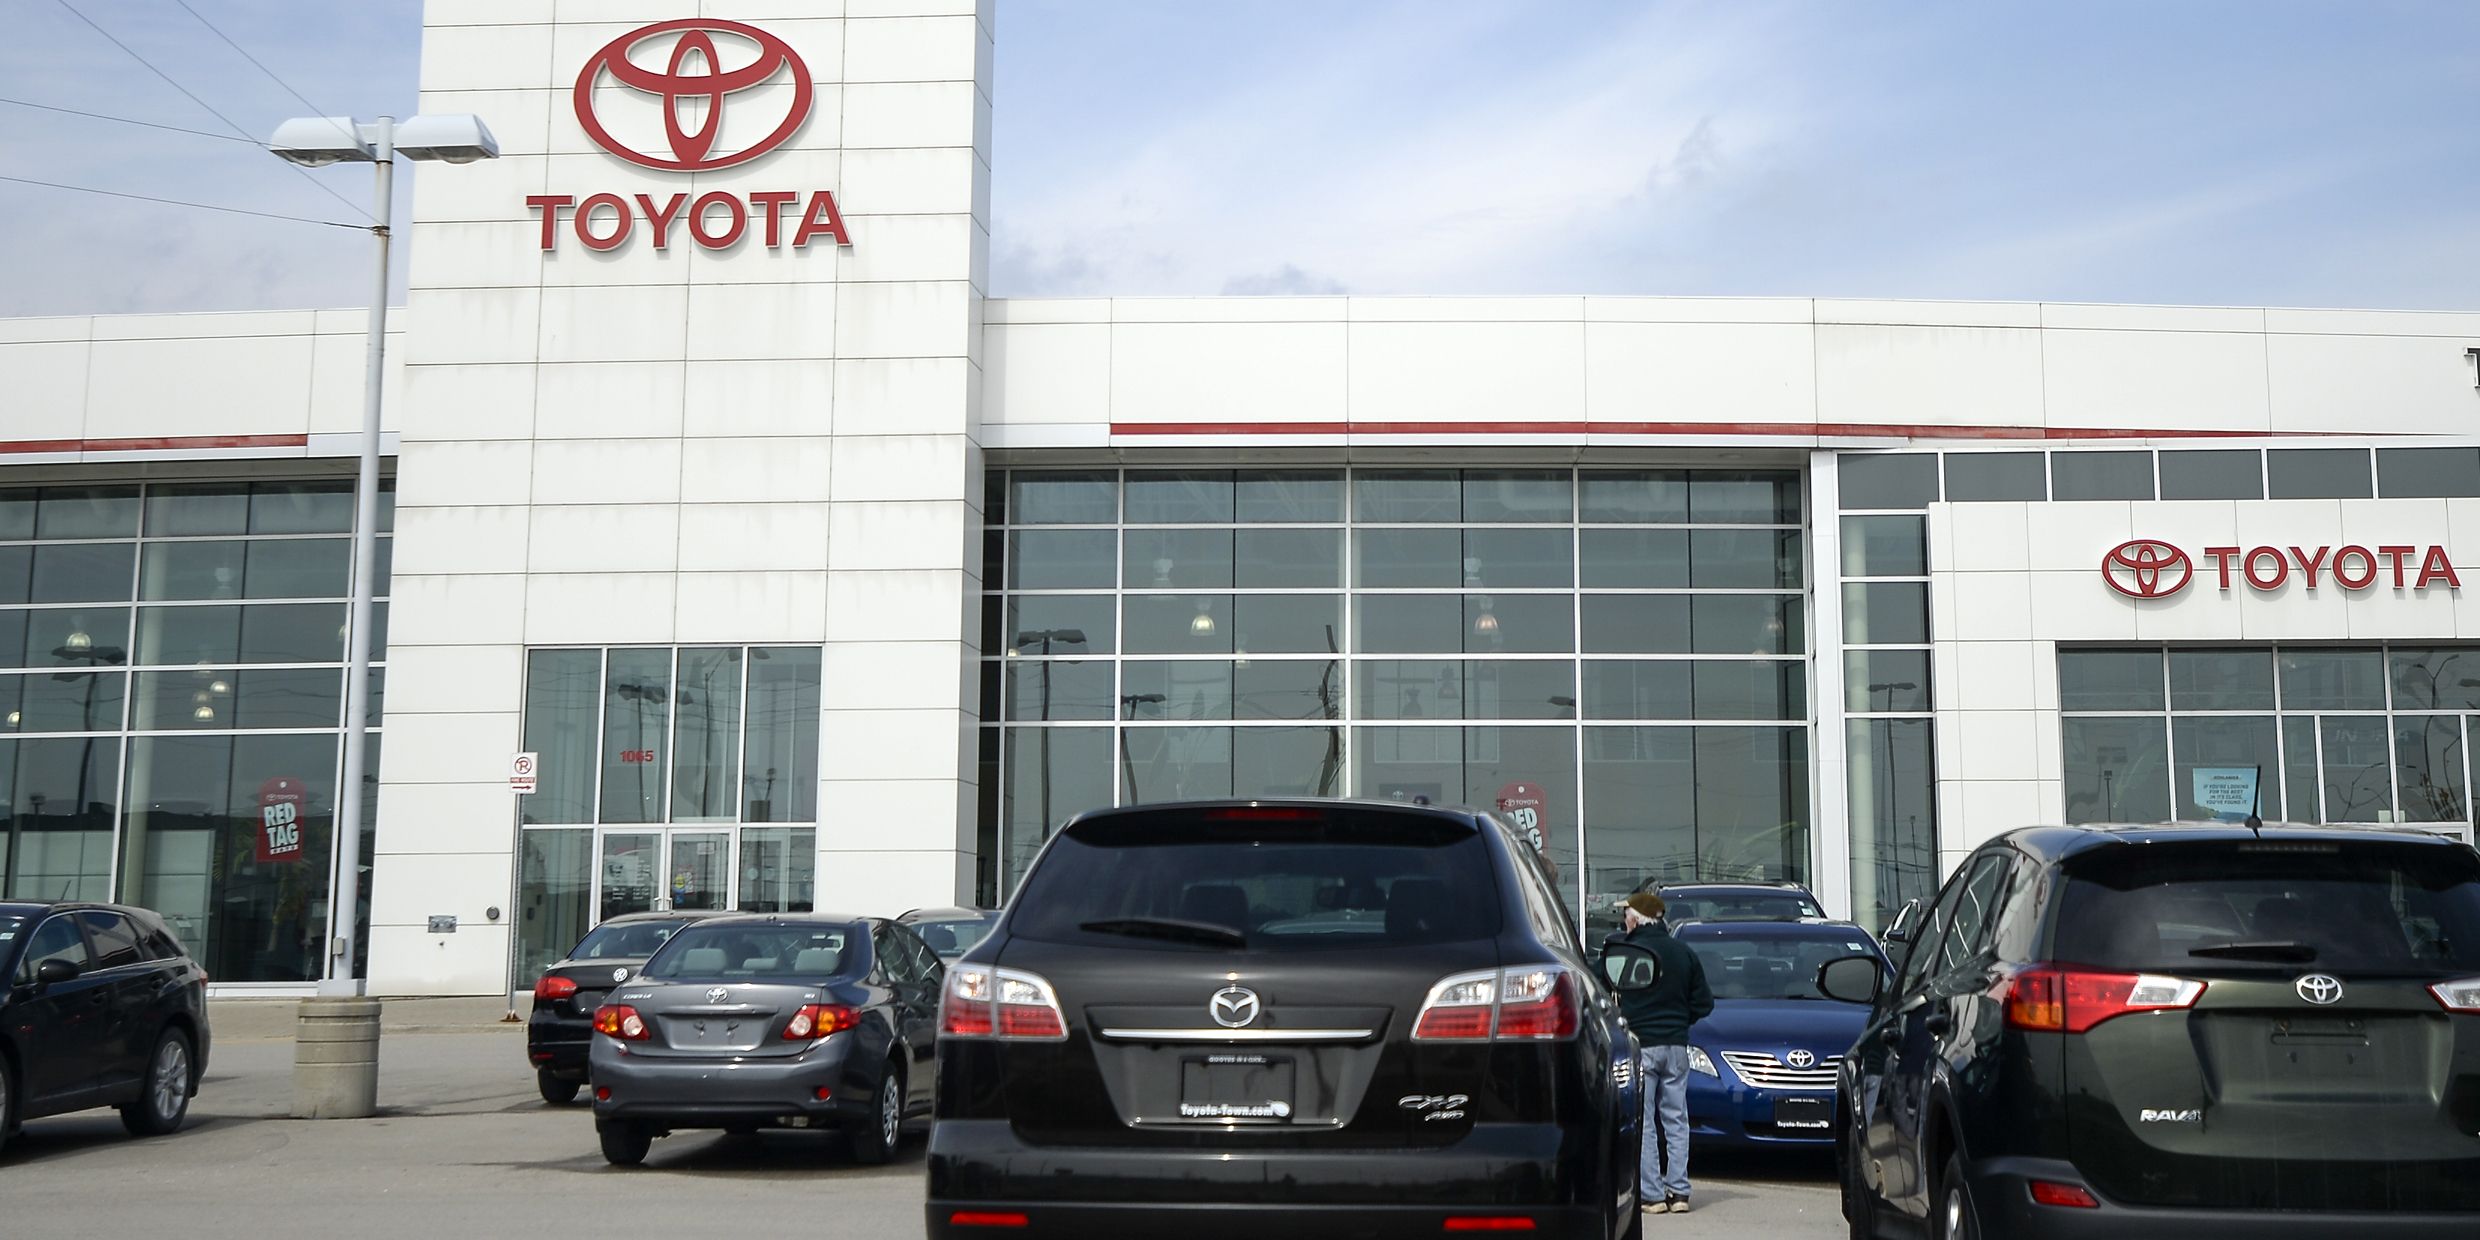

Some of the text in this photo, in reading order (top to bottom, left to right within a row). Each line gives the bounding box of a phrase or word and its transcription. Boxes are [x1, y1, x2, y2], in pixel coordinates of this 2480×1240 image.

[526, 190, 853, 251] TOYOTA
[2203, 545, 2462, 591] TOYOTA
[619, 750, 654, 762] 1065
[264, 802, 296, 827] RED
[266, 823, 300, 849] TAG
[1181, 1103, 1275, 1118] Toyota-Town.com
[2140, 1109, 2201, 1122] RAV4
